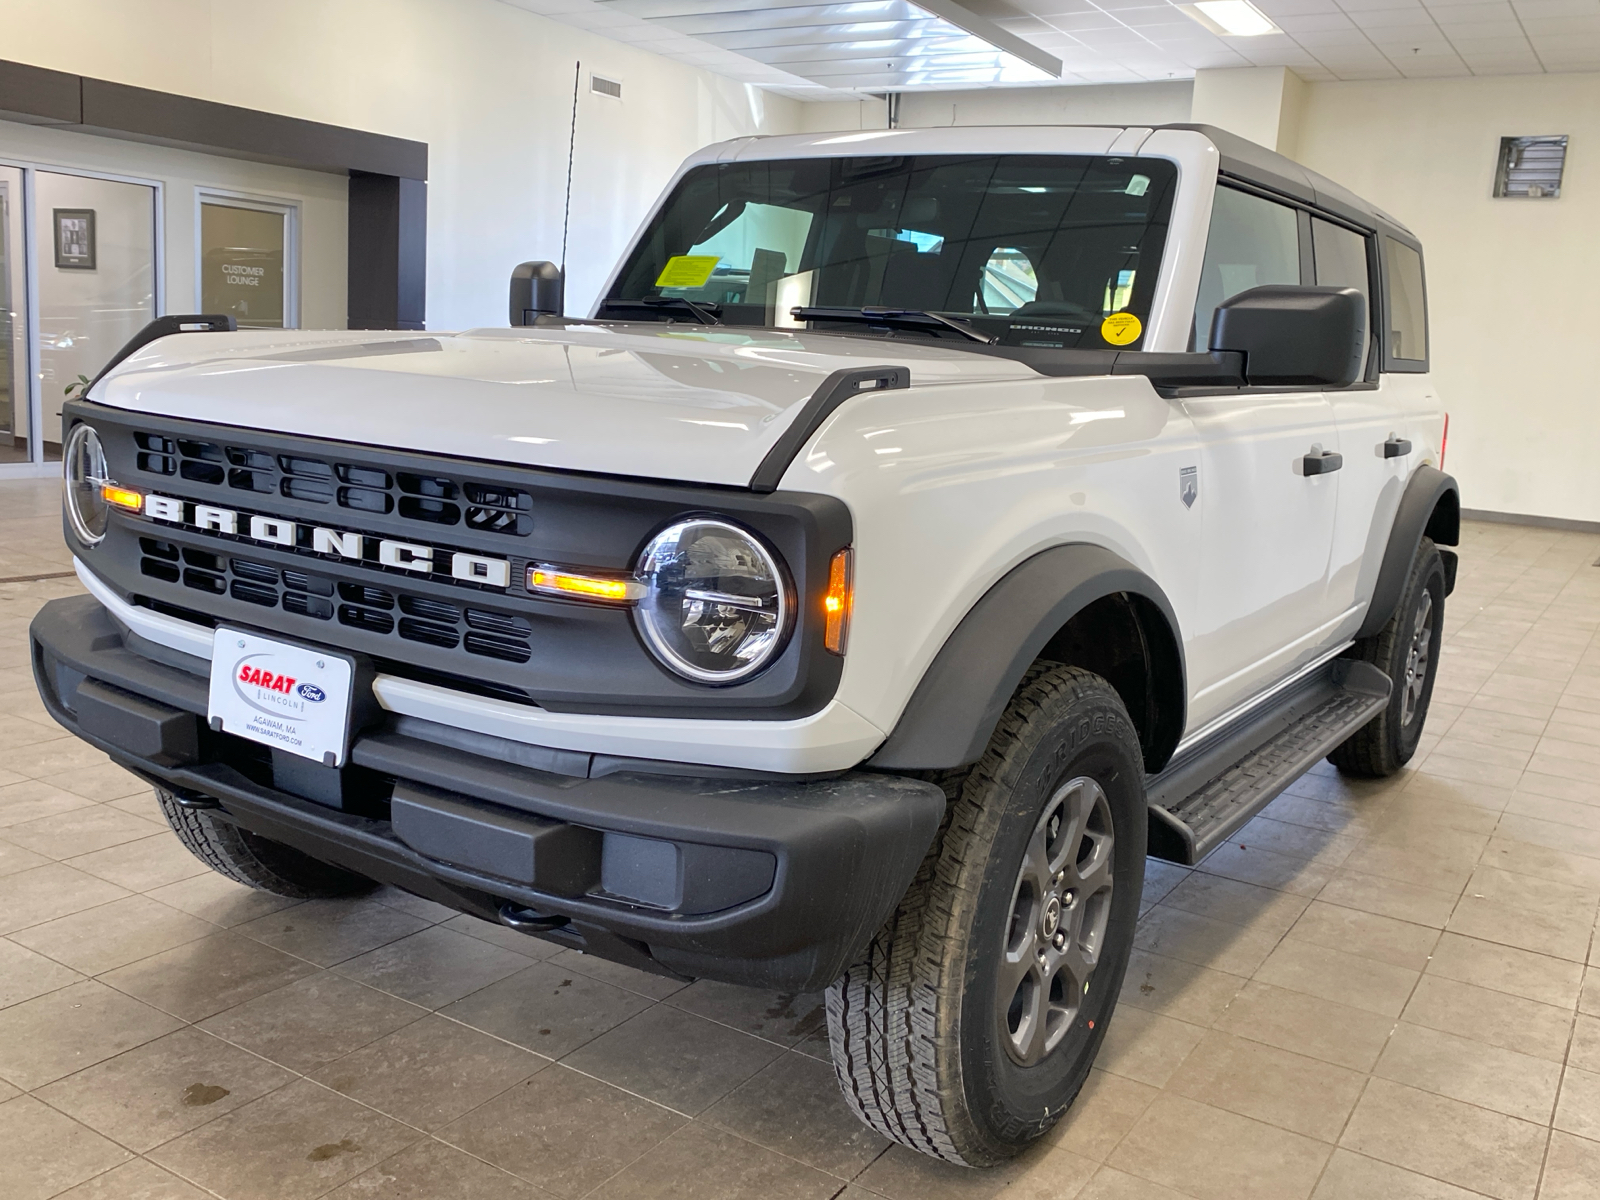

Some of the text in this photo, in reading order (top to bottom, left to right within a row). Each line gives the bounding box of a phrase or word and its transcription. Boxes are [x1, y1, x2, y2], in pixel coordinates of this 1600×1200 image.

[222, 264, 264, 276] CUSTOMER
[227, 275, 259, 286] LOUNGE
[1010, 324, 1081, 334] BRONCO
[145, 494, 511, 588] BRONCO
[239, 665, 322, 701] SARAT Ford
[263, 692, 299, 709] LINCOLN
[253, 715, 297, 735] AGAWAM, MA
[245, 723, 303, 746] WWW.SARATFORD.COM
